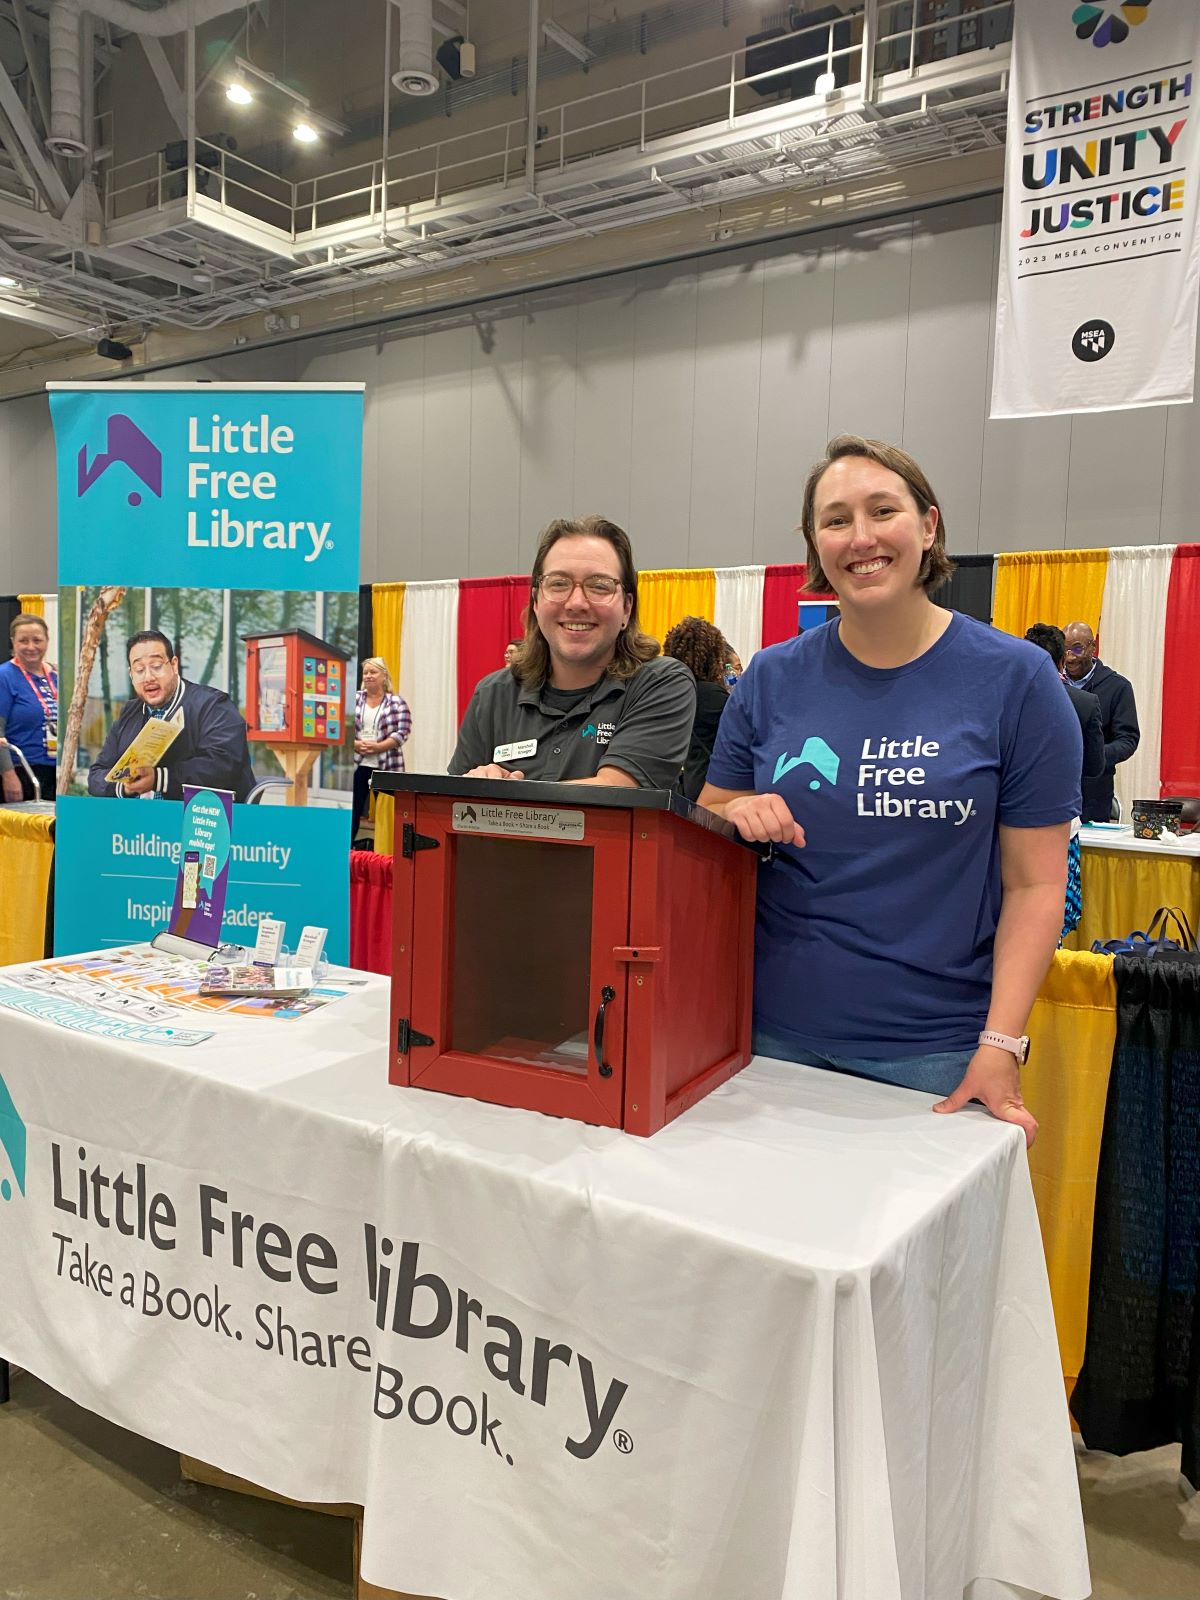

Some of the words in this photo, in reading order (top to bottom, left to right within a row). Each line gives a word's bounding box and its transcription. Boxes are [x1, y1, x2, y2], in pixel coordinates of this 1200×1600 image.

[1024, 73, 1192, 133] STRENGTH
[1022, 118, 1188, 190] UNITY
[1020, 179, 1185, 238] JUSTICE
[1018, 255, 1047, 266] 2023
[1054, 248, 1087, 260] MSEA
[1094, 231, 1182, 253] CONVENTION
[1081, 329, 1105, 339] MSEA
[188, 414, 294, 454] Little
[188, 463, 276, 500] Free
[596, 729, 613, 737] Free
[596, 736, 611, 745] Libr
[597, 722, 616, 731] Little
[861, 736, 940, 760] Little
[858, 764, 926, 787] Free
[192, 816, 204, 825] Little
[205, 818, 217, 828] Free
[481, 807, 503, 819] Little
[505, 809, 524, 820] Free
[195, 827, 212, 840] Library
[112, 833, 182, 864] Building
[230, 841, 292, 870] munity
[127, 898, 173, 928] Inspir
[51, 1142, 177, 1251] Little
[199, 1184, 338, 1295] Free
[52, 1231, 113, 1297] Take
[119, 1272, 135, 1308] a
[141, 1269, 243, 1341] Book.
[255, 1303, 372, 1373] Share
[373, 1362, 514, 1466] Book.
